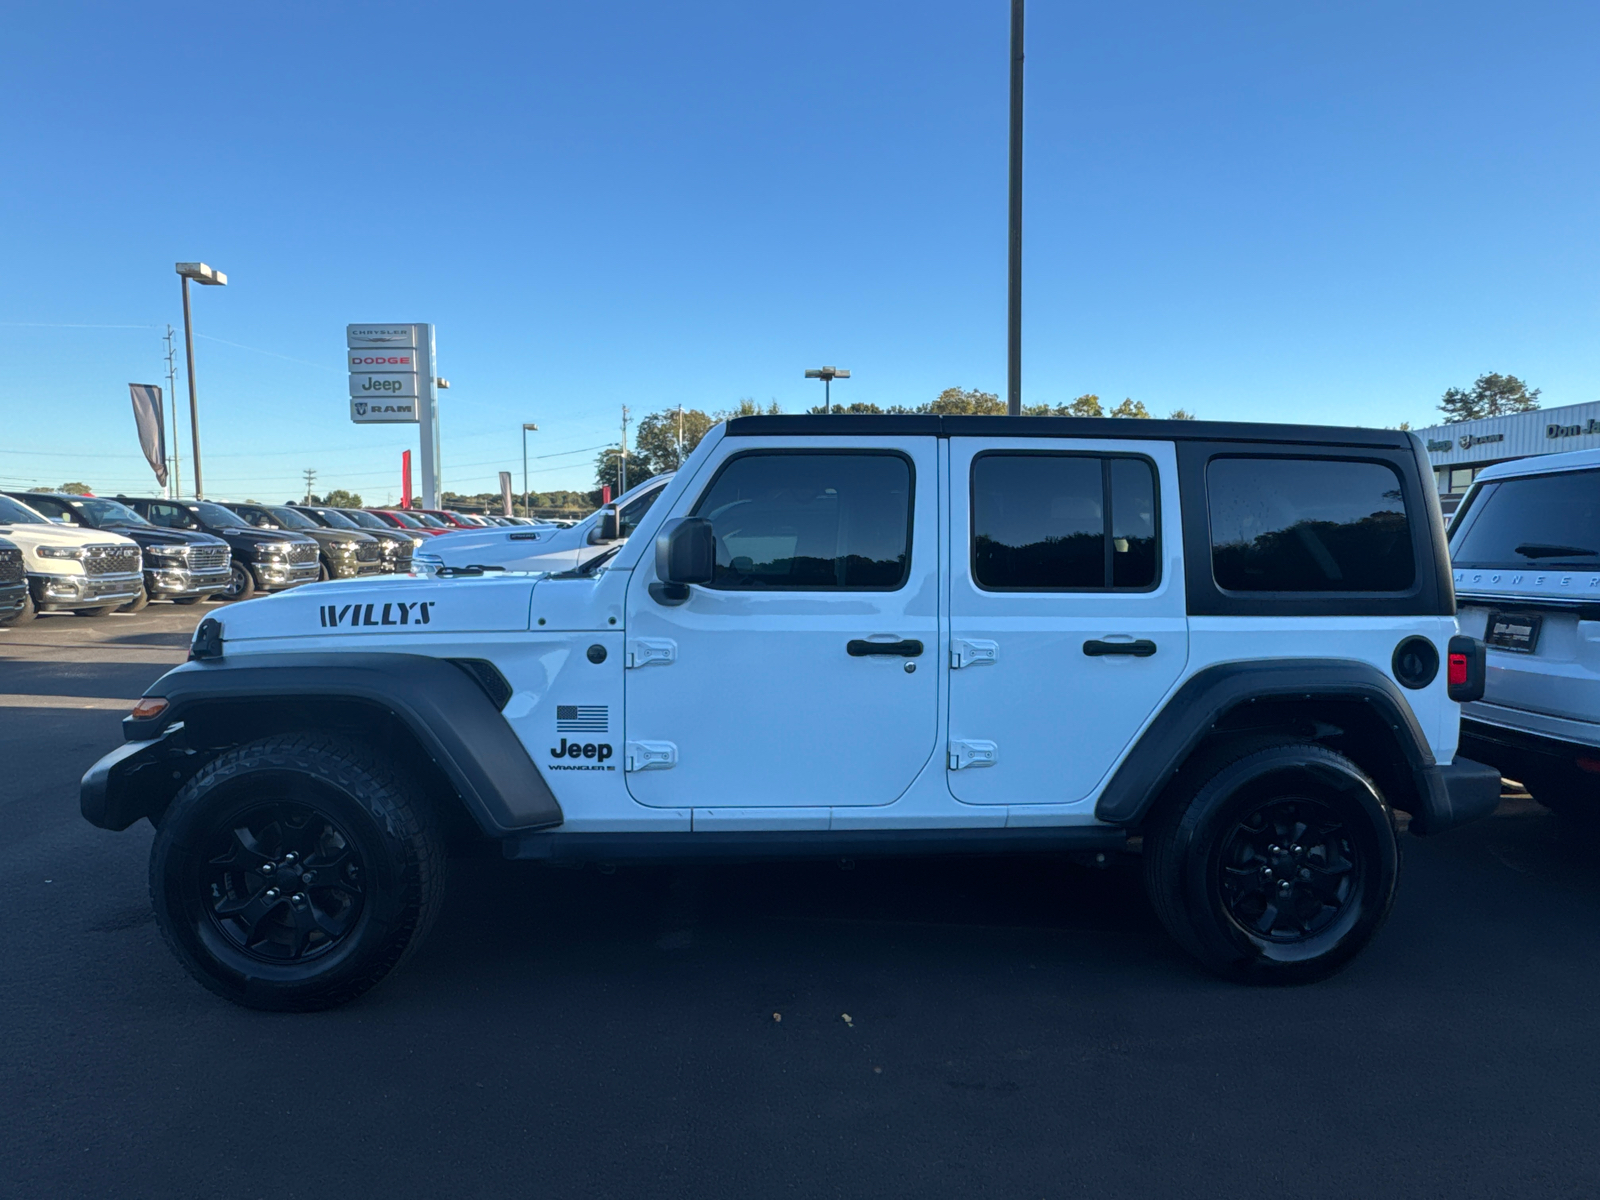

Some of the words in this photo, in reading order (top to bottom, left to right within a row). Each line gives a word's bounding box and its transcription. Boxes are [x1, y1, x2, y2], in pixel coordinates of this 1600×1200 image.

[362, 377, 402, 393] Jeep
[1546, 424, 1581, 439] Don
[1427, 439, 1452, 452] Jeep
[320, 602, 435, 627] WILLYS
[550, 738, 613, 763] Jeep
